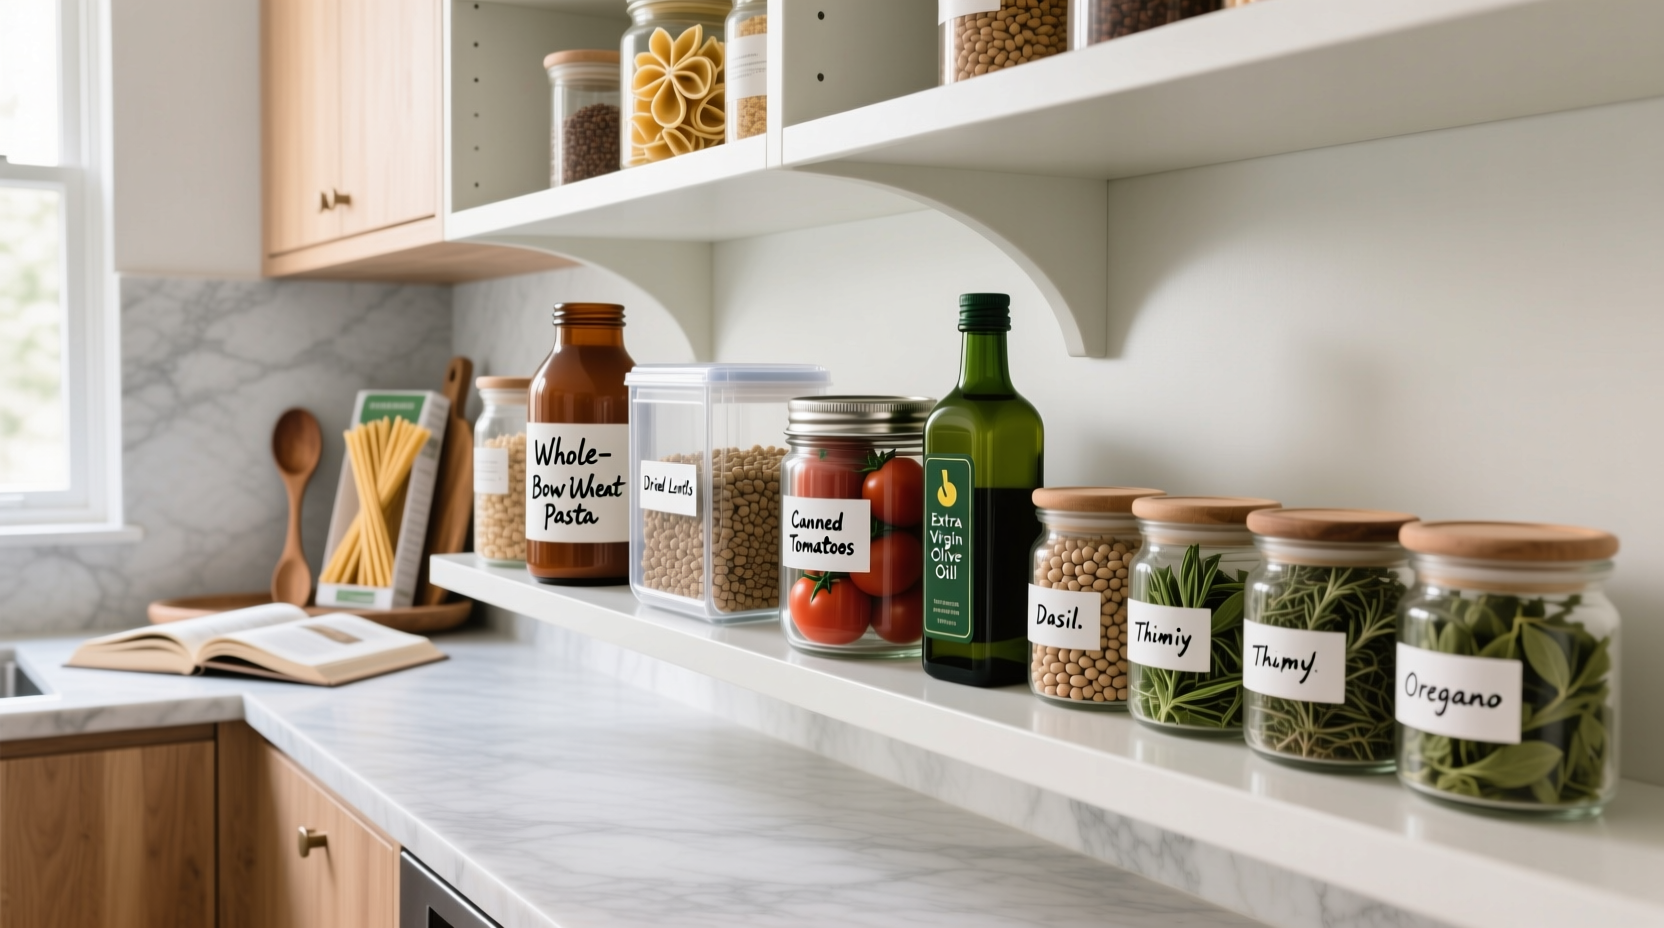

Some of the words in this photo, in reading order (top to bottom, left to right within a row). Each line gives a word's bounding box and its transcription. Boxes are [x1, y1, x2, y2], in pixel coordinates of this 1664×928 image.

[534, 435, 612, 467] Whole-
[532, 474, 566, 500] Bow
[544, 502, 600, 531] Pasta
[791, 509, 844, 532] Canned
[929, 529, 963, 550] Virgin
[930, 547, 962, 563] Olive
[1405, 671, 1503, 717] Oregano
